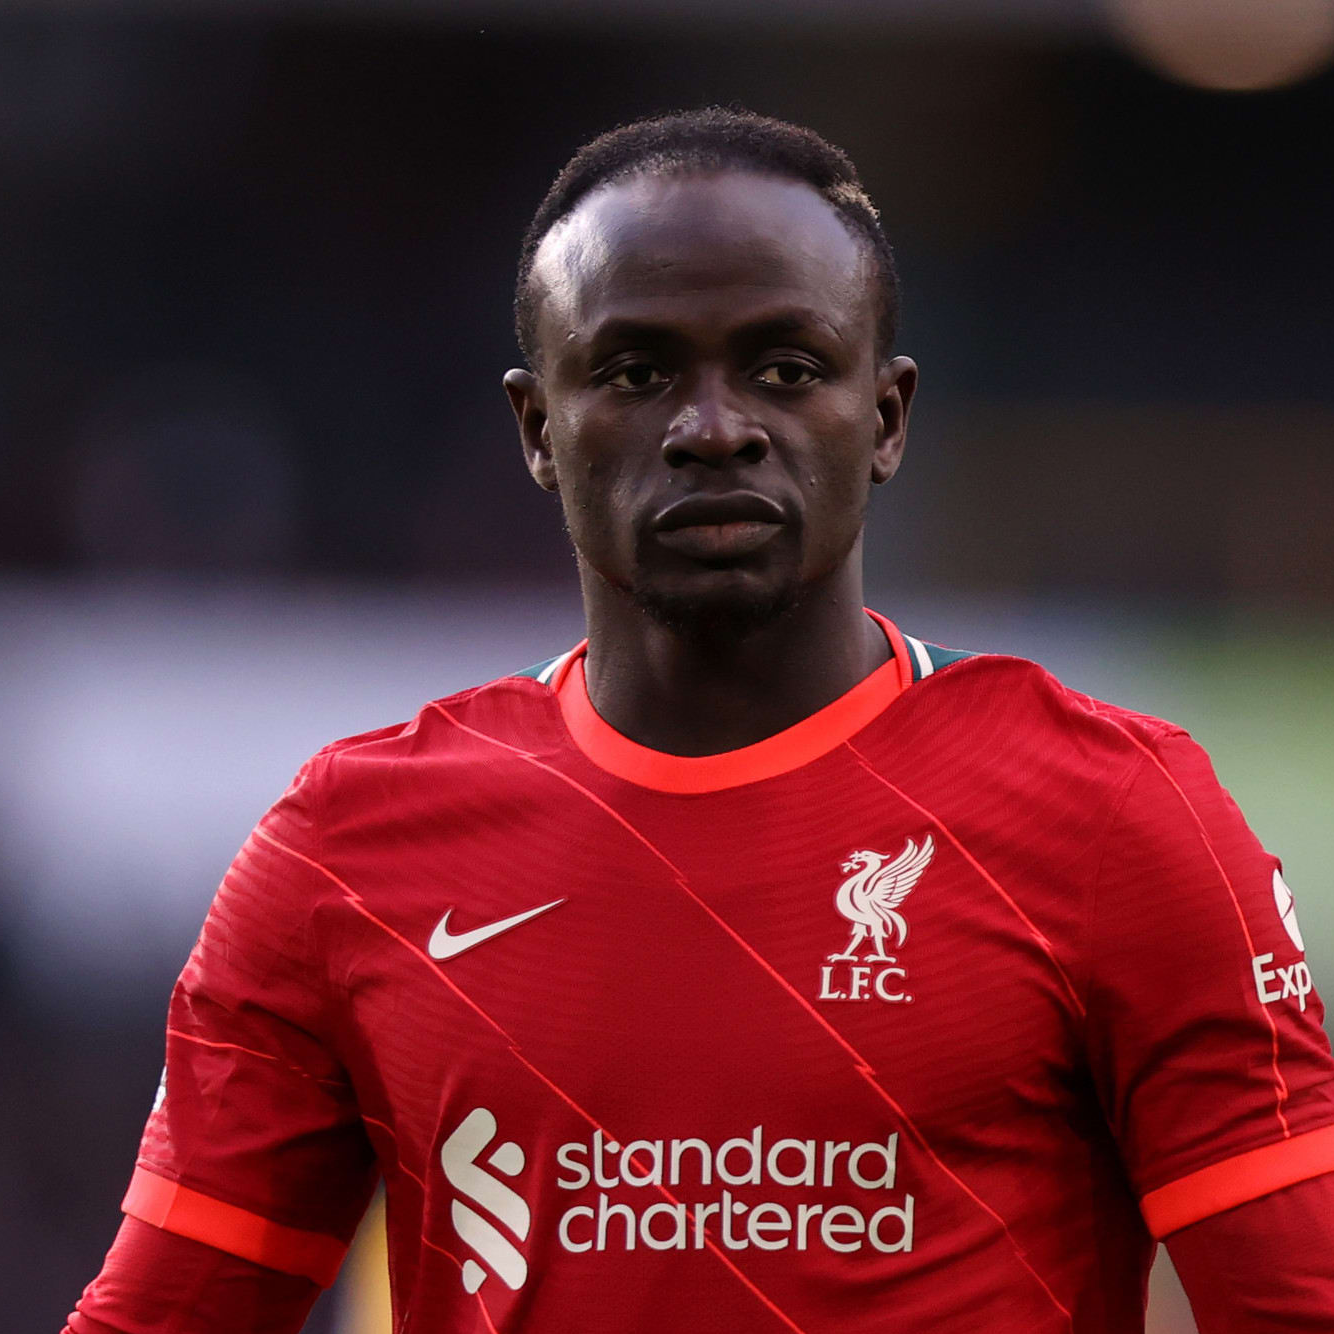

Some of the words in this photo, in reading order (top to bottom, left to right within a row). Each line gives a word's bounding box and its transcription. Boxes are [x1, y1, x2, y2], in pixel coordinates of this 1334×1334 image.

[818, 965, 913, 1002] L.F.C.
[556, 1124, 899, 1190] standard
[558, 1190, 915, 1253] chartered
